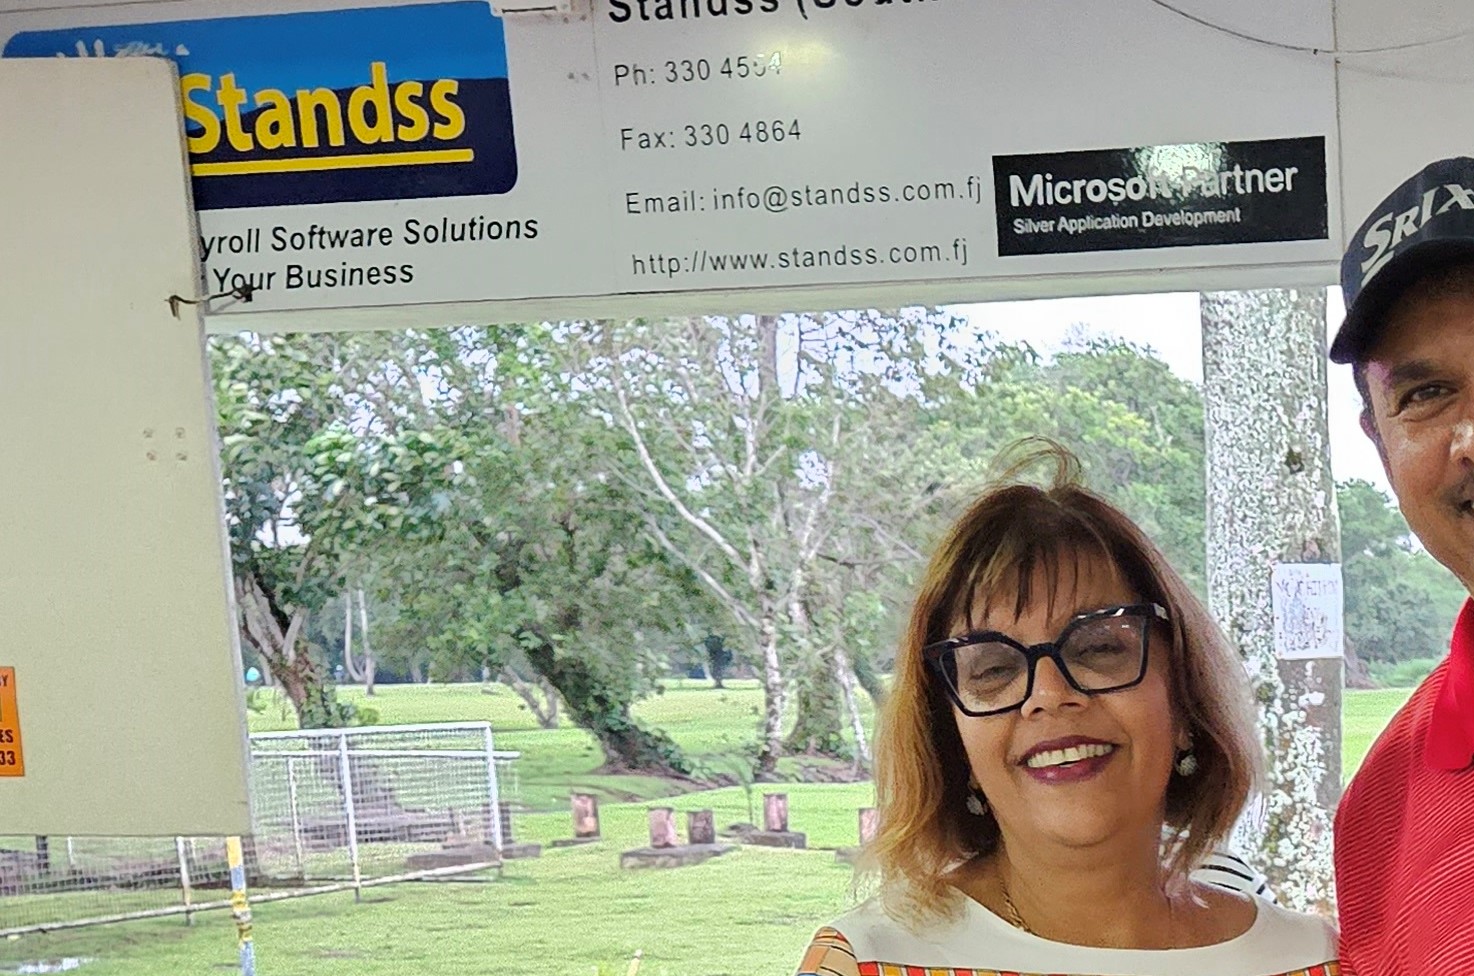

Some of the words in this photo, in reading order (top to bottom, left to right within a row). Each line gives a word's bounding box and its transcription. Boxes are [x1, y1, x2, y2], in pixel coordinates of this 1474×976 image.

[614, 63, 655, 86] Ph:
[664, 59, 711, 83] 330
[180, 61, 466, 154] Standss
[621, 128, 675, 150] Fax:
[684, 123, 730, 147] 330
[739, 119, 801, 143] 4864
[626, 190, 705, 215] Email:
[713, 176, 982, 213] info@standss.com.fj
[1009, 168, 1172, 208] Microsoft
[1182, 163, 1299, 198] Partner
[270, 224, 393, 251] Software
[404, 215, 539, 245] Solutions
[1013, 218, 1055, 235] Silver
[1057, 214, 1138, 235] Application
[1142, 207, 1241, 228] Development
[632, 238, 968, 279] http://www.standss.com.fj
[213, 268, 276, 292] Your
[285, 262, 414, 289] Business
